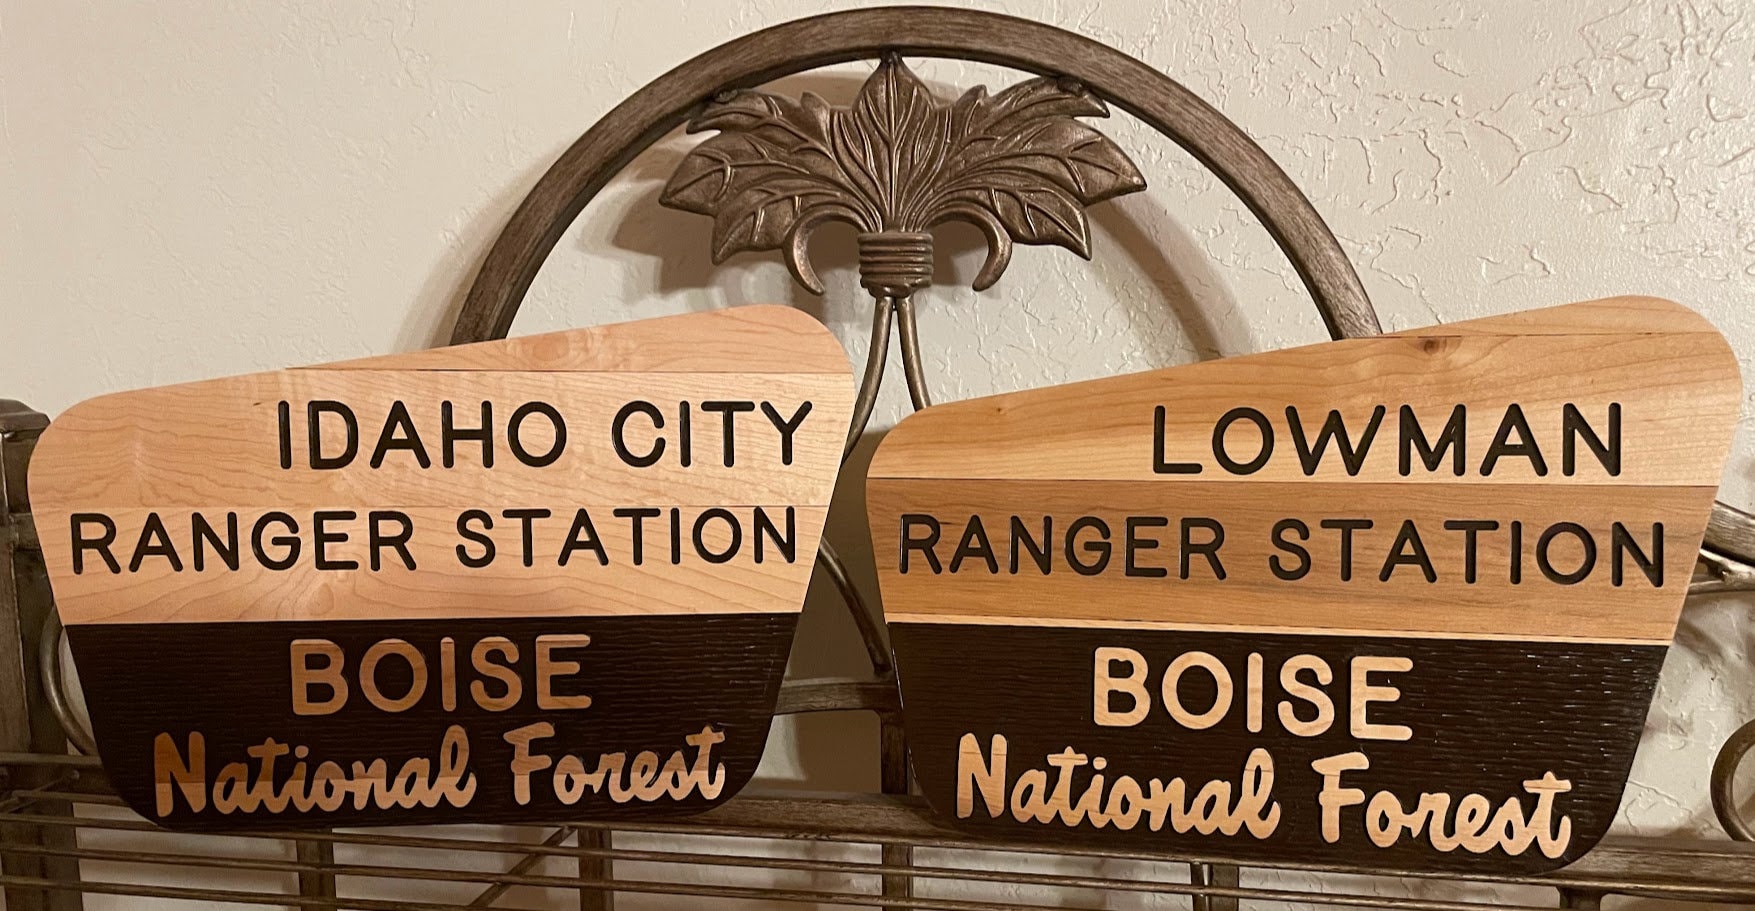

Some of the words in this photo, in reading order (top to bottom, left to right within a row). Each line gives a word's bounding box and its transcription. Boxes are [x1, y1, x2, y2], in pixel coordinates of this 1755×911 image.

[277, 400, 567, 469] IDAHO
[612, 400, 813, 467] CITY
[1152, 402, 1622, 476] LOWMAN
[72, 511, 418, 574] RANGER
[455, 506, 797, 567] STATION
[899, 514, 1228, 580] RANGER
[1268, 518, 1665, 588] STATION
[290, 635, 592, 715] BOISE
[1093, 647, 1414, 741] BOISE
[153, 724, 477, 817] National
[506, 721, 727, 806] Forest
[956, 734, 1281, 839] National
[1311, 752, 1572, 859] Forest
